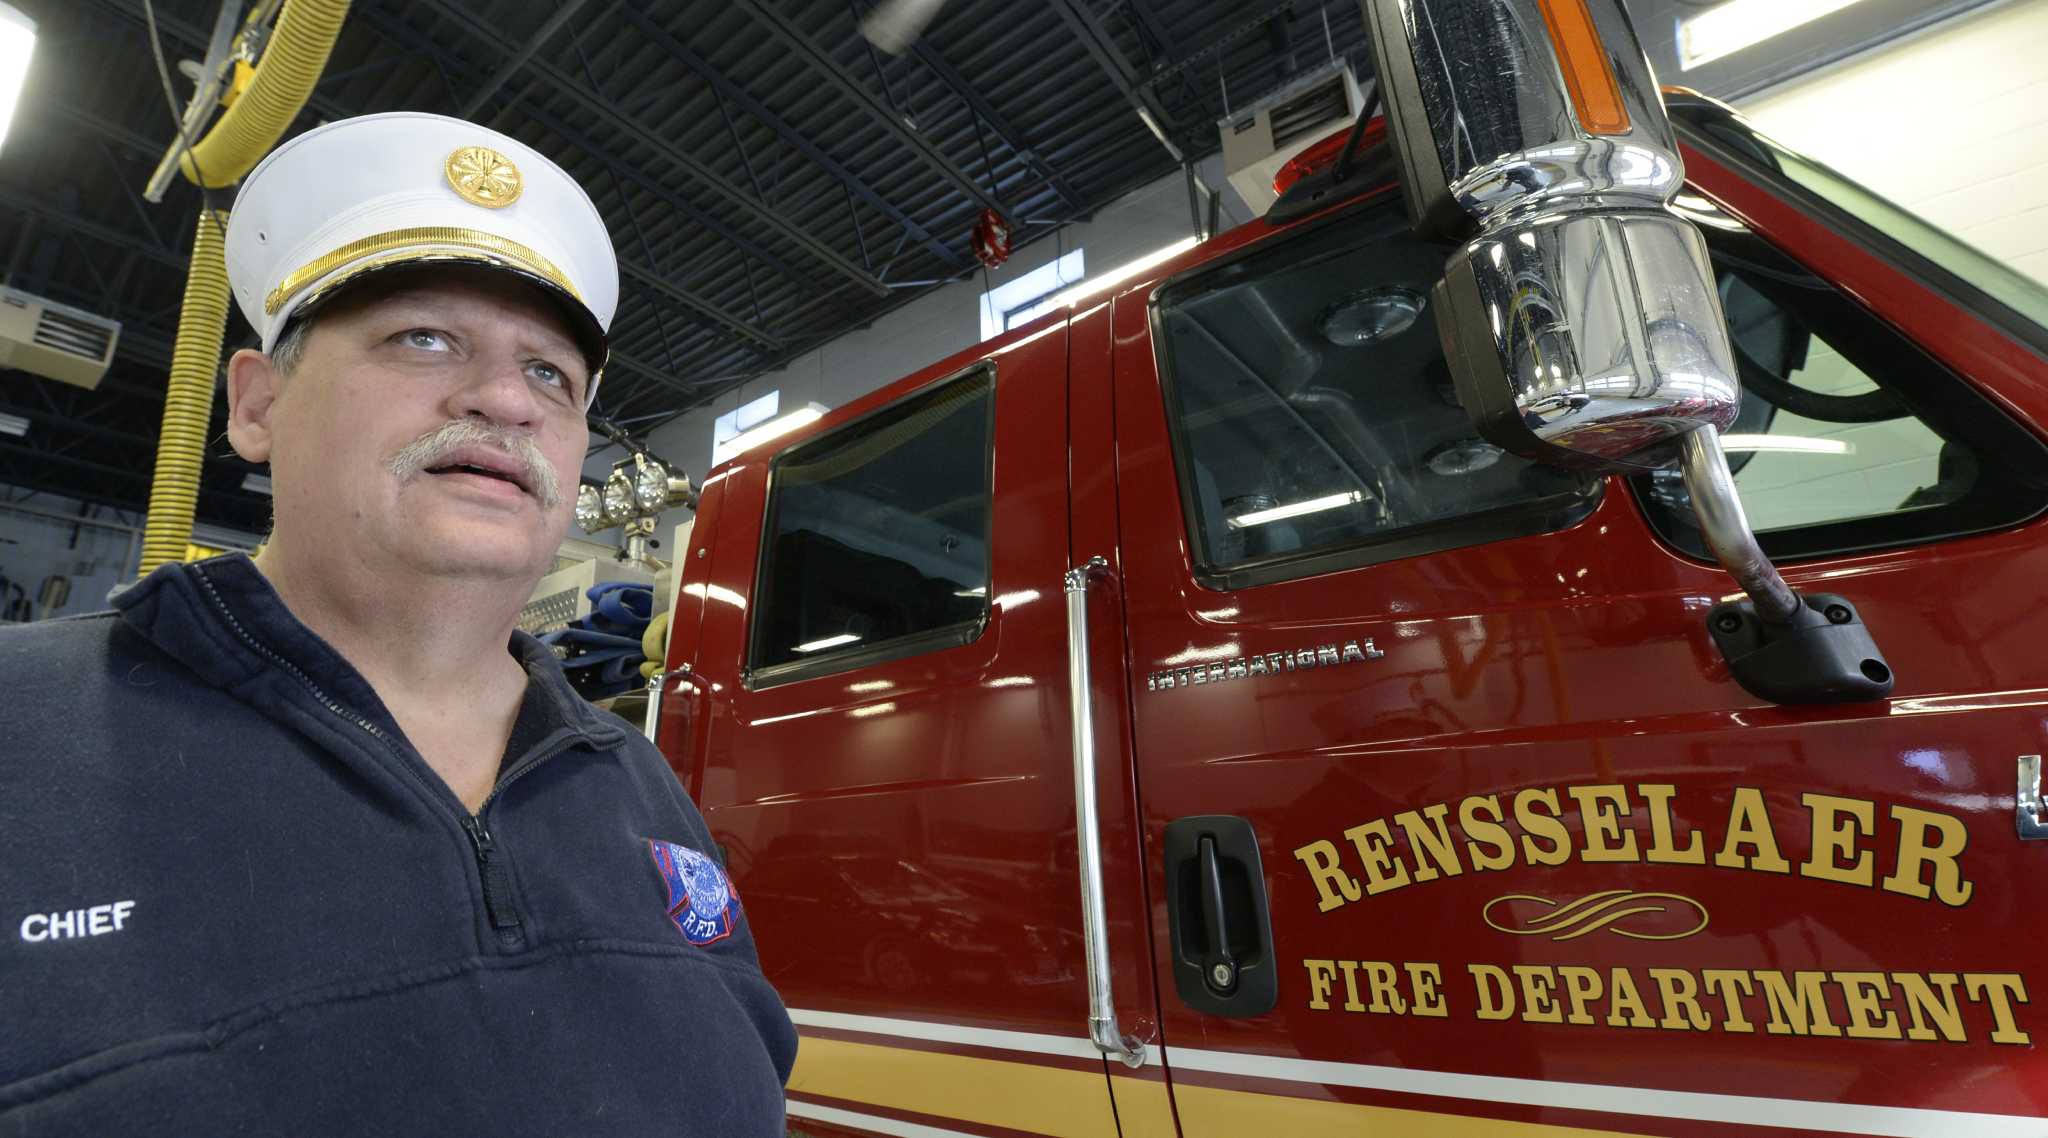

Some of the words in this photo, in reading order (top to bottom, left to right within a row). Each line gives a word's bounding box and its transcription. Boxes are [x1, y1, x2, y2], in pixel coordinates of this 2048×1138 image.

[1148, 637, 1384, 691] INTERNATIONAL
[1294, 783, 1974, 912] RENSSELAER
[20, 900, 136, 942] CHIEF
[683, 910, 718, 937] R.F.D.
[1303, 958, 1450, 1017] FIRE
[1466, 963, 2031, 1046] DEPARTMENT
